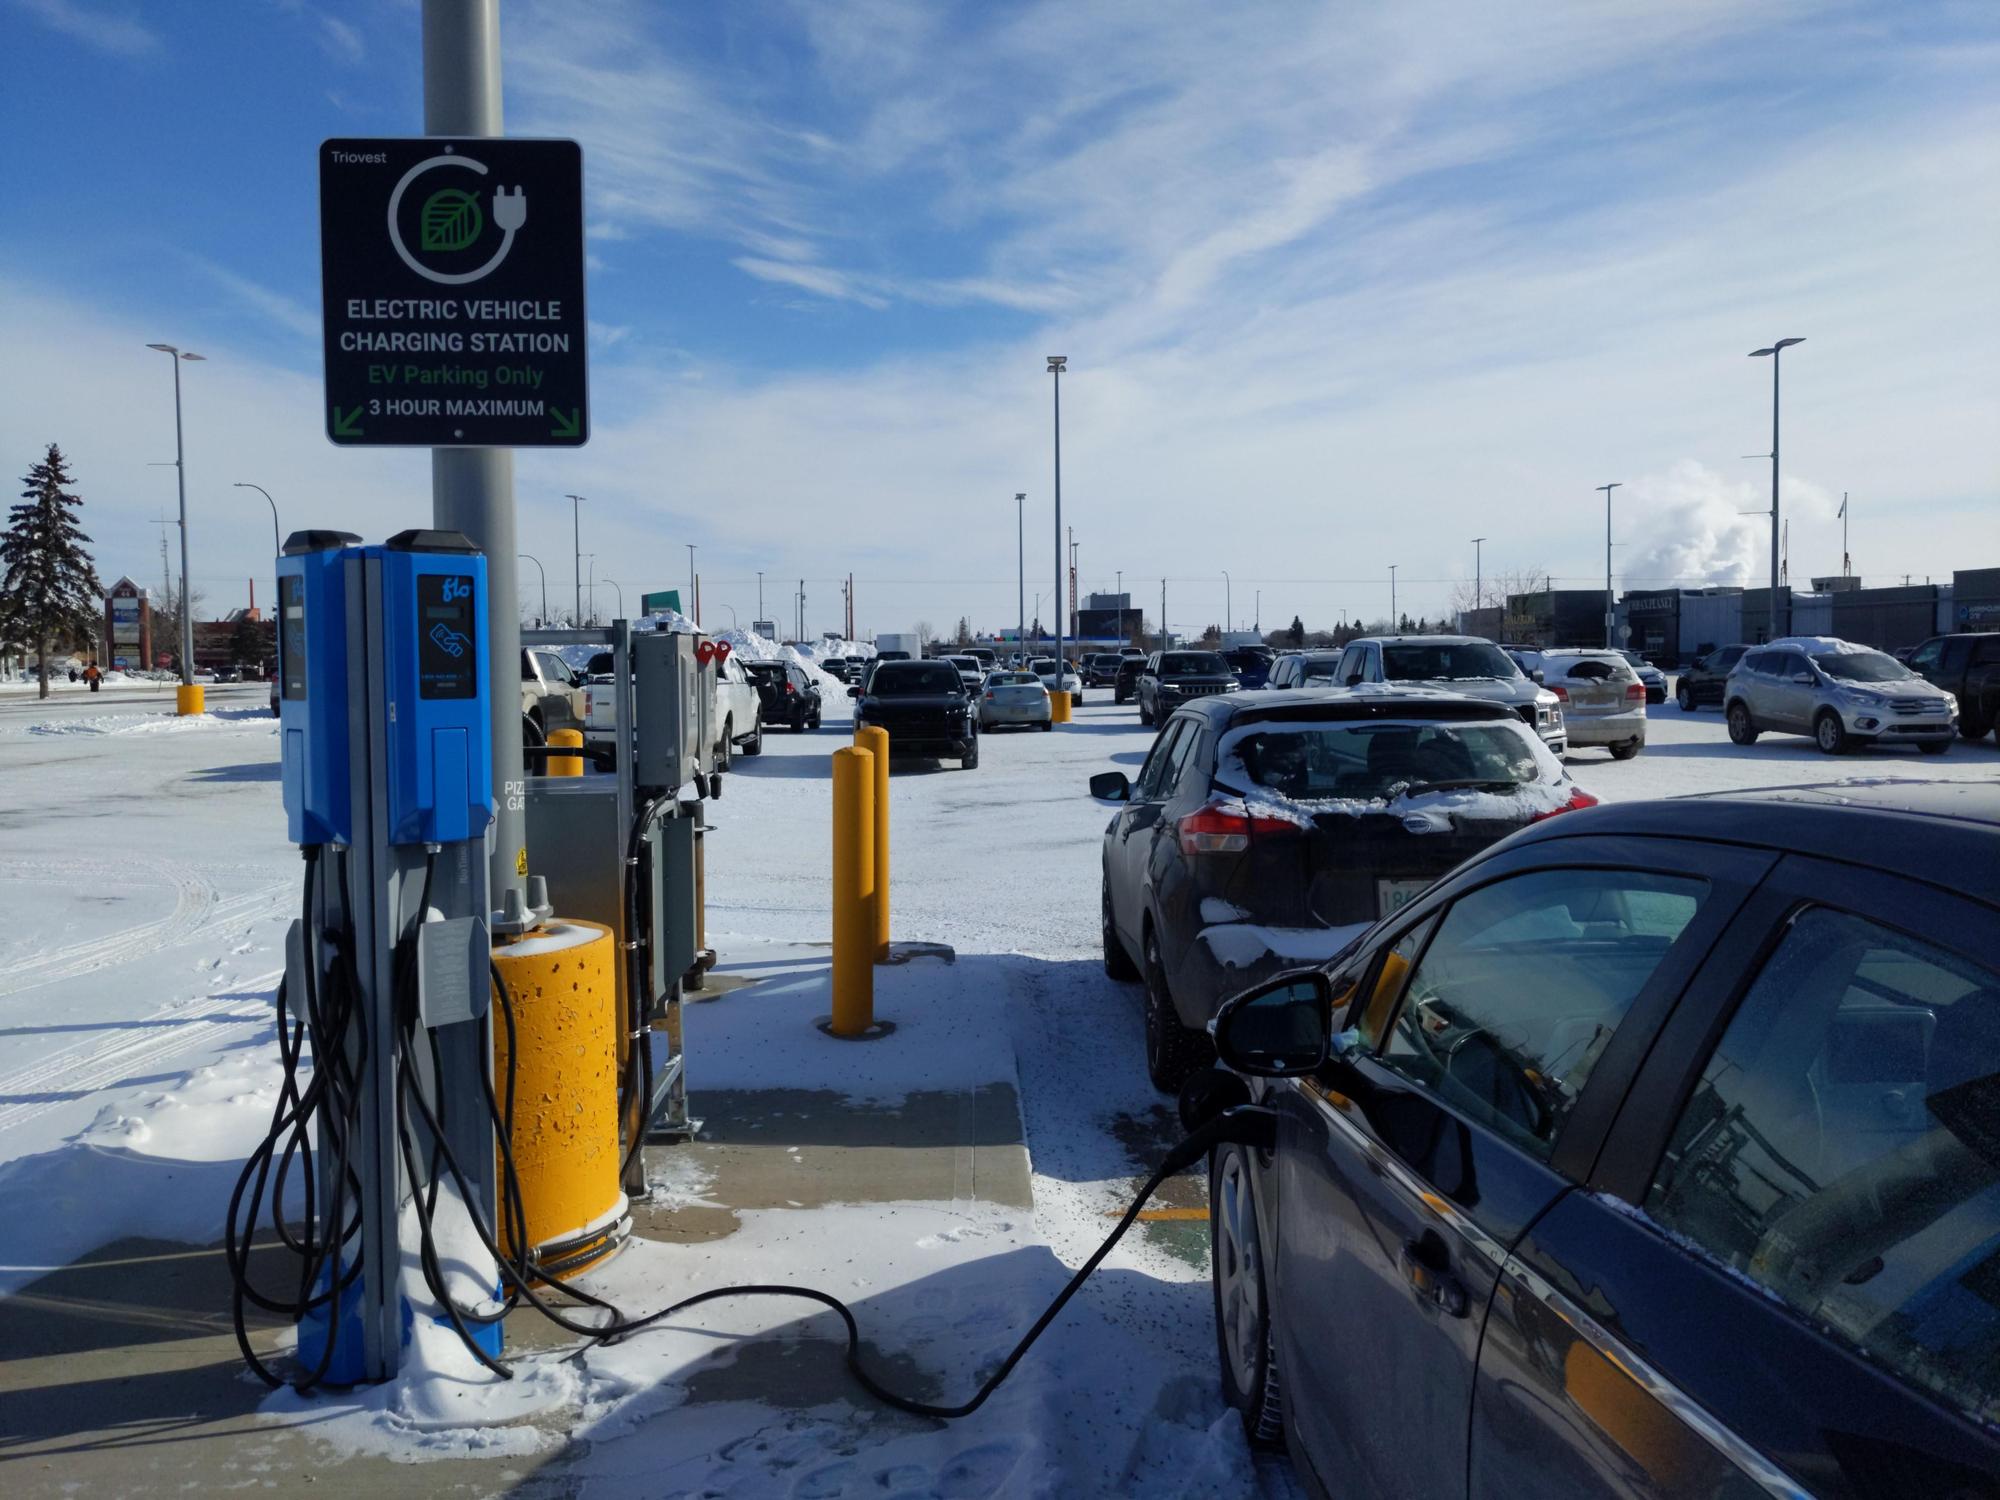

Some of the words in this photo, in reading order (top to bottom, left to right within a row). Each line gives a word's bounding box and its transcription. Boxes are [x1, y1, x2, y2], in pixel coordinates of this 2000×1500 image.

[331, 151, 387, 164] Triovest
[347, 299, 458, 319] ELECTRIC
[463, 300, 562, 321] VEHICLE
[340, 331, 463, 351] CHARGING
[470, 333, 569, 353] STATION
[368, 365, 397, 384] EV
[404, 365, 488, 389] Parking
[495, 366, 544, 389] Only
[369, 399, 381, 416] 3
[386, 399, 441, 416] HOUR
[446, 399, 544, 416] MAXIMUM
[442, 576, 470, 602] flo
[506, 796, 525, 811] GA
